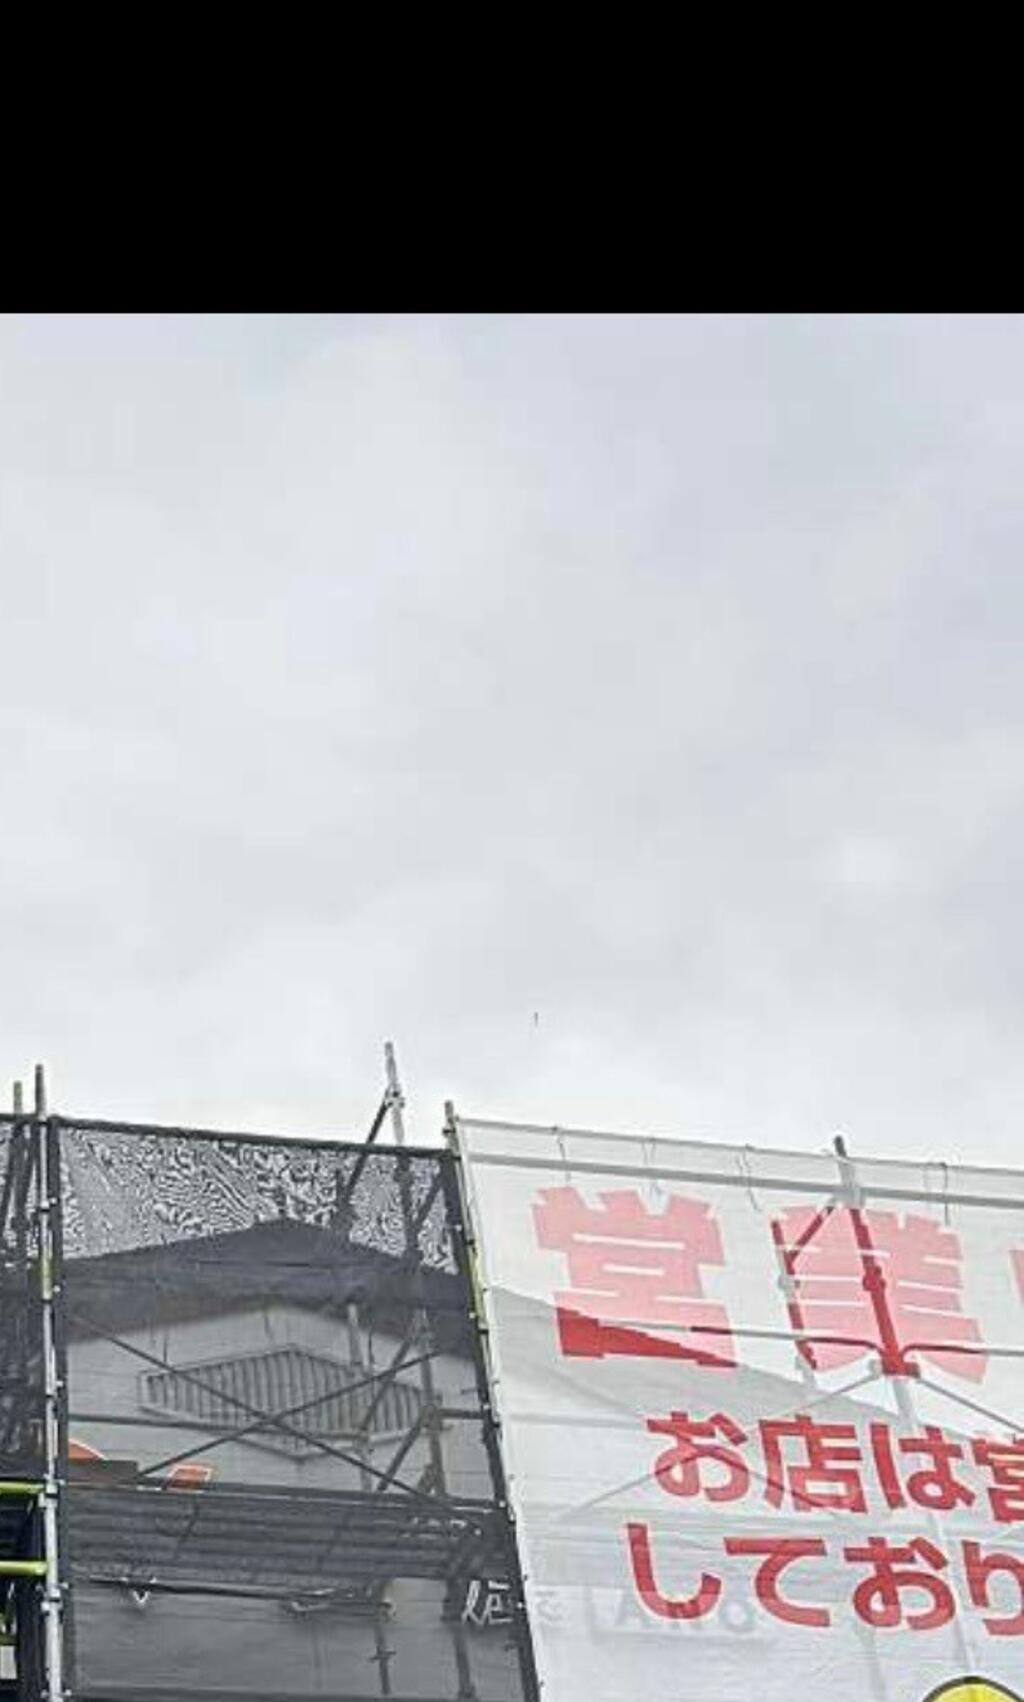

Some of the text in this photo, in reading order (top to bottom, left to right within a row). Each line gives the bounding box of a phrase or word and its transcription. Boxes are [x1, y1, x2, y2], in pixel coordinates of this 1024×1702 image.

[531, 1186, 1024, 1384] 営業
[626, 1523, 1024, 1635] しており
